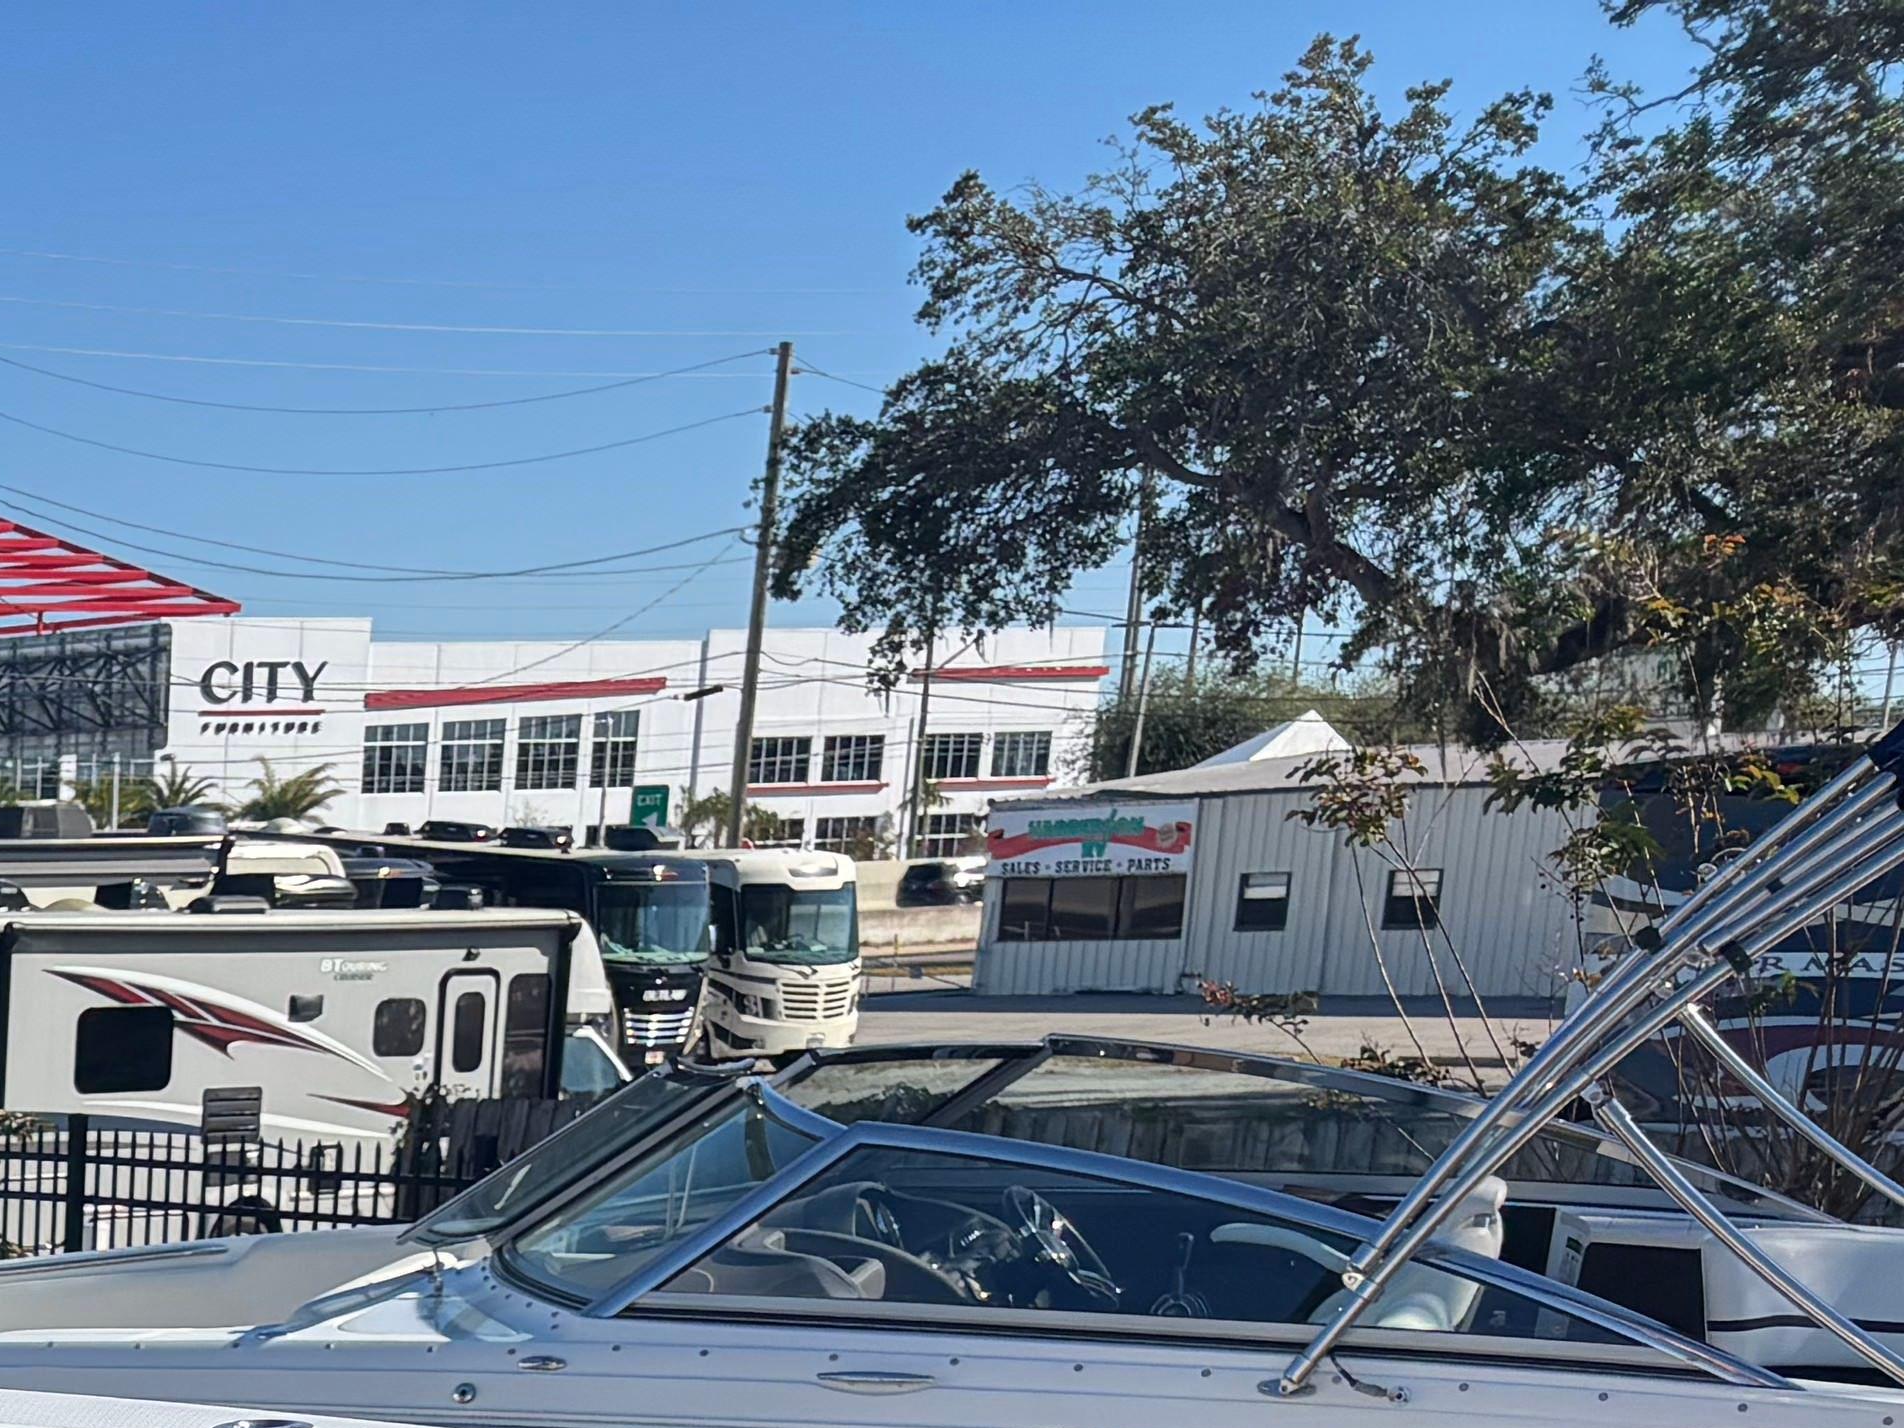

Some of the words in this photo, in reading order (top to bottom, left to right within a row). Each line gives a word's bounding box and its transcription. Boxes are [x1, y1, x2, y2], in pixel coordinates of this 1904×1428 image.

[200, 661, 328, 704] CITY
[637, 794, 662, 806] EXIT
[1002, 861, 1040, 875] SALES
[1055, 859, 1112, 874] SERVICE
[1127, 858, 1171, 873] PARTS
